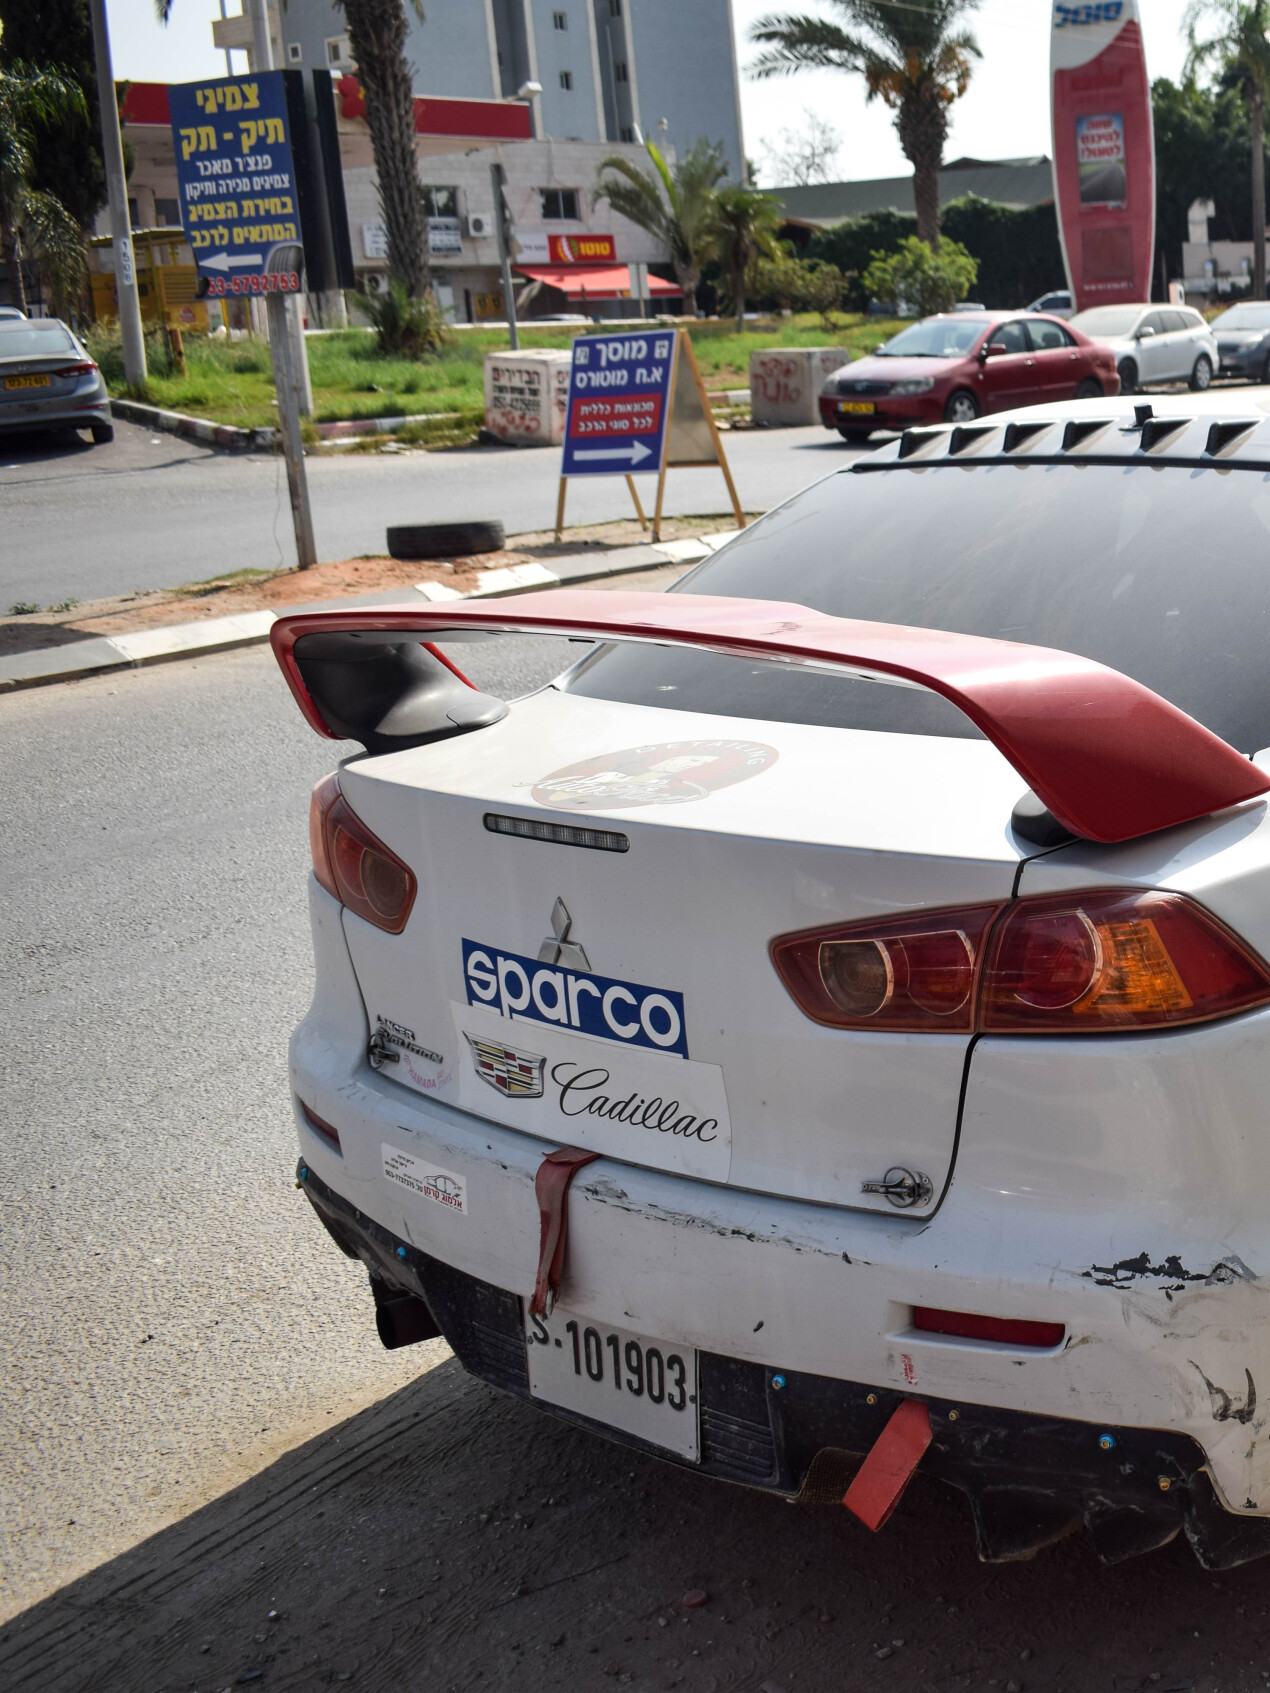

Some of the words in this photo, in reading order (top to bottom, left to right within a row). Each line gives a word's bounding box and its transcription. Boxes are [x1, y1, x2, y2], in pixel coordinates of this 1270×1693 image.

[196, 82, 260, 114] צמיגי
[179, 126, 217, 160] תק
[239, 117, 285, 154] תיק
[196, 158, 232, 176] מאכר
[185, 183, 217, 201] ותיקון
[219, 178, 251, 195] מכירה
[252, 174, 290, 191] צמיגים
[189, 202, 238, 222] הצמיג
[242, 197, 293, 217] בחירת
[191, 225, 230, 248] לרכב
[233, 223, 297, 244] המתאים
[579, 242, 612, 256] טוטו
[207, 272, 299, 296] 53-5792753
[595, 339, 648, 367] מוסך
[575, 369, 628, 389] מוטורס
[580, 402, 611, 416] כללית
[613, 401, 655, 415] מכונאות
[578, 420, 607, 432] הרכב
[608, 419, 630, 430] סוגי
[632, 416, 653, 429] לכל
[467, 950, 681, 1047] sparco
[377, 1014, 416, 1041] LANCER
[551, 1062, 719, 1142] Cadillac
